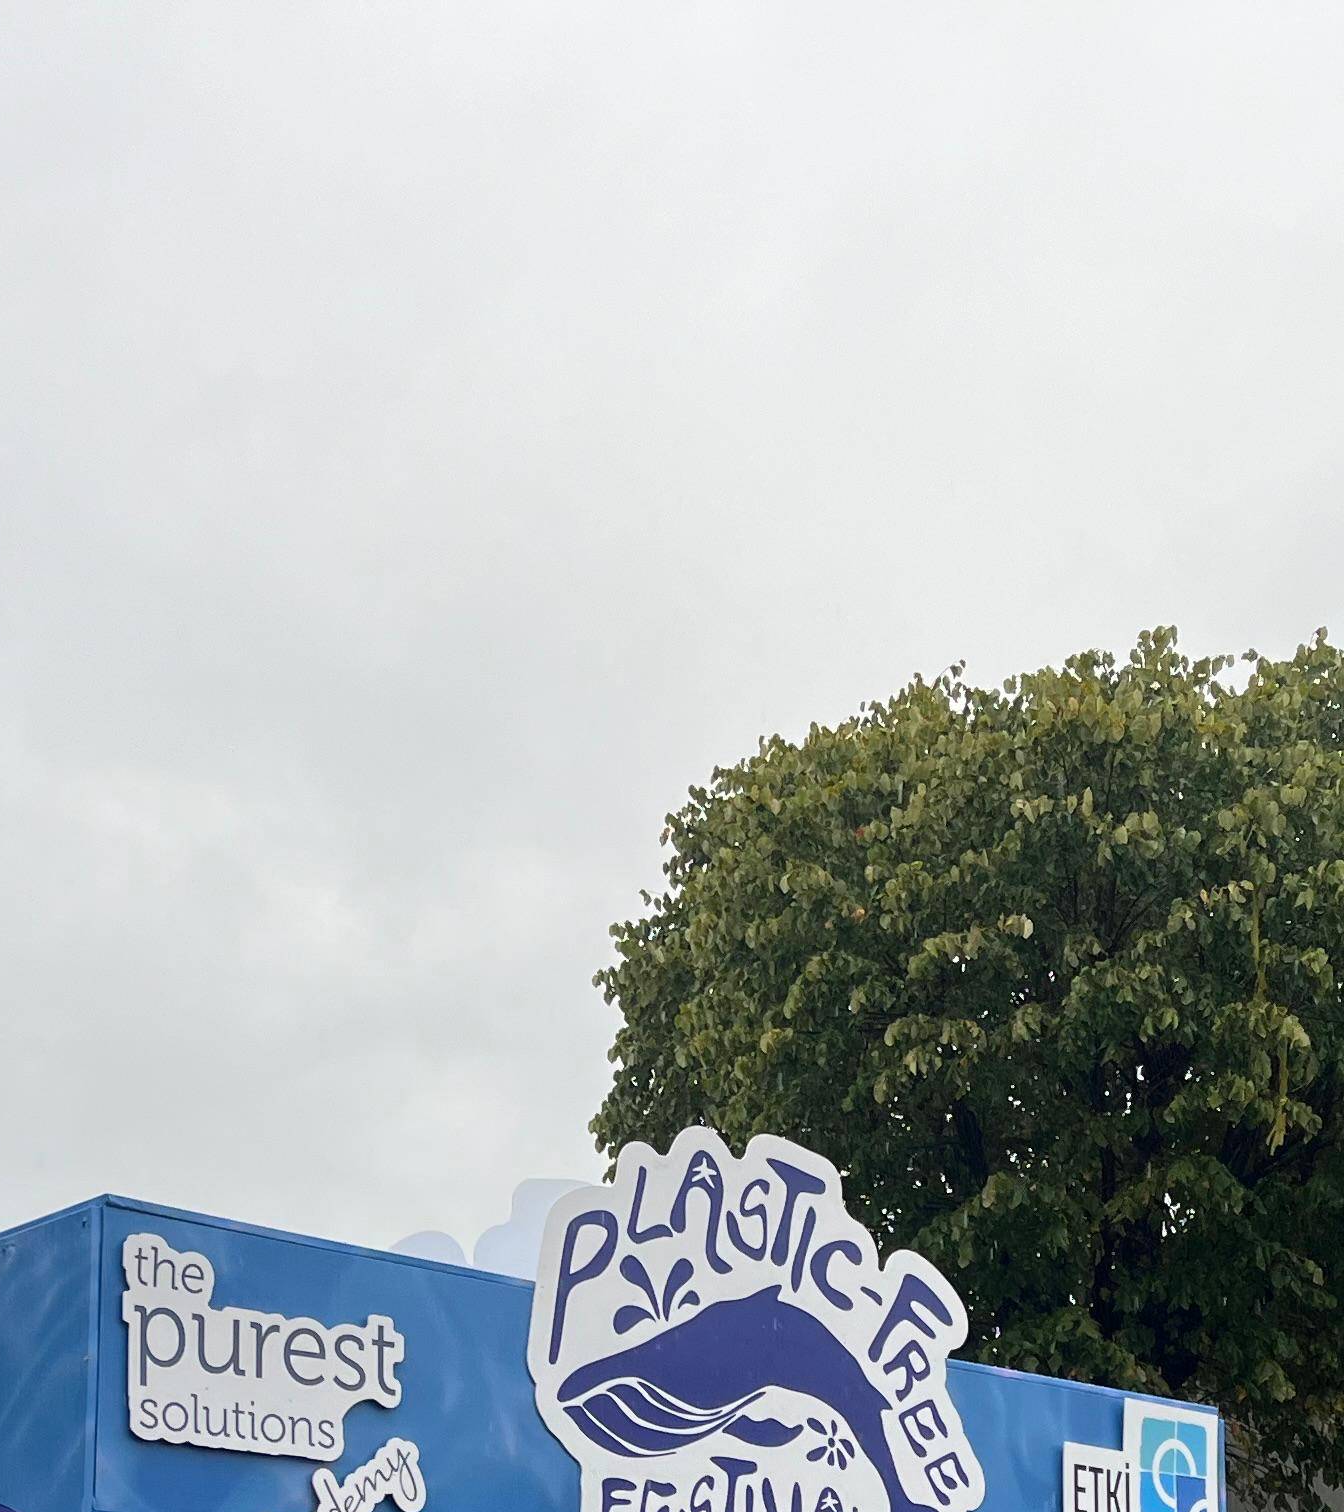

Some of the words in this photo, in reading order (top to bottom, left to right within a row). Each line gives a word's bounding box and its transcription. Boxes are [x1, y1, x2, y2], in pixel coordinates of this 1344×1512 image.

[134, 1246, 205, 1295] the
[134, 1304, 397, 1396] purest
[139, 1393, 336, 1450] solutions
